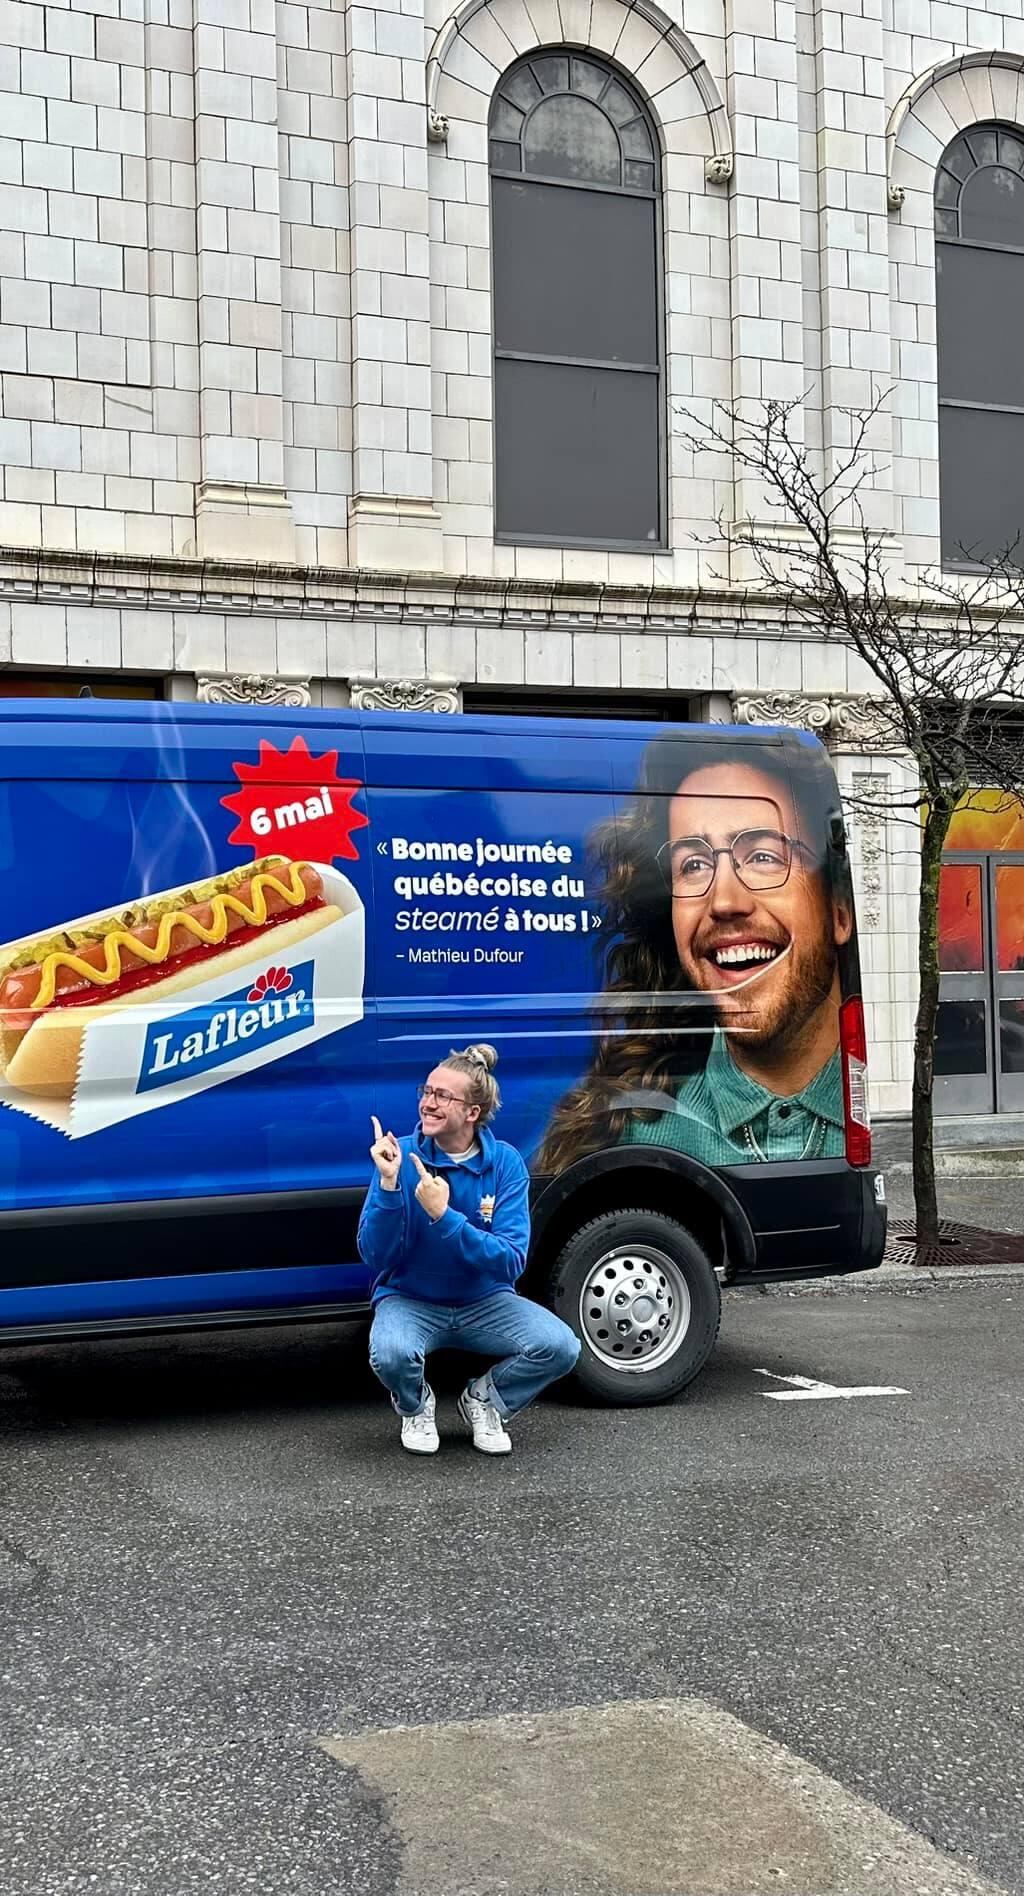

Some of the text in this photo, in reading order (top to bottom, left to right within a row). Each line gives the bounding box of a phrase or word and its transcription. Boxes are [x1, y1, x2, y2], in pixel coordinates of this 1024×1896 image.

[250, 786, 334, 836] 6 mai
[391, 838, 474, 861] Bonne
[475, 837, 573, 867] journée
[393, 872, 585, 901] québécoise du
[394, 906, 500, 931] steamé
[503, 908, 520, 931] à
[522, 909, 577, 932] tous
[408, 948, 470, 963] Mathieu
[474, 948, 525, 964] Dufour
[147, 989, 307, 1076] Lafleur
